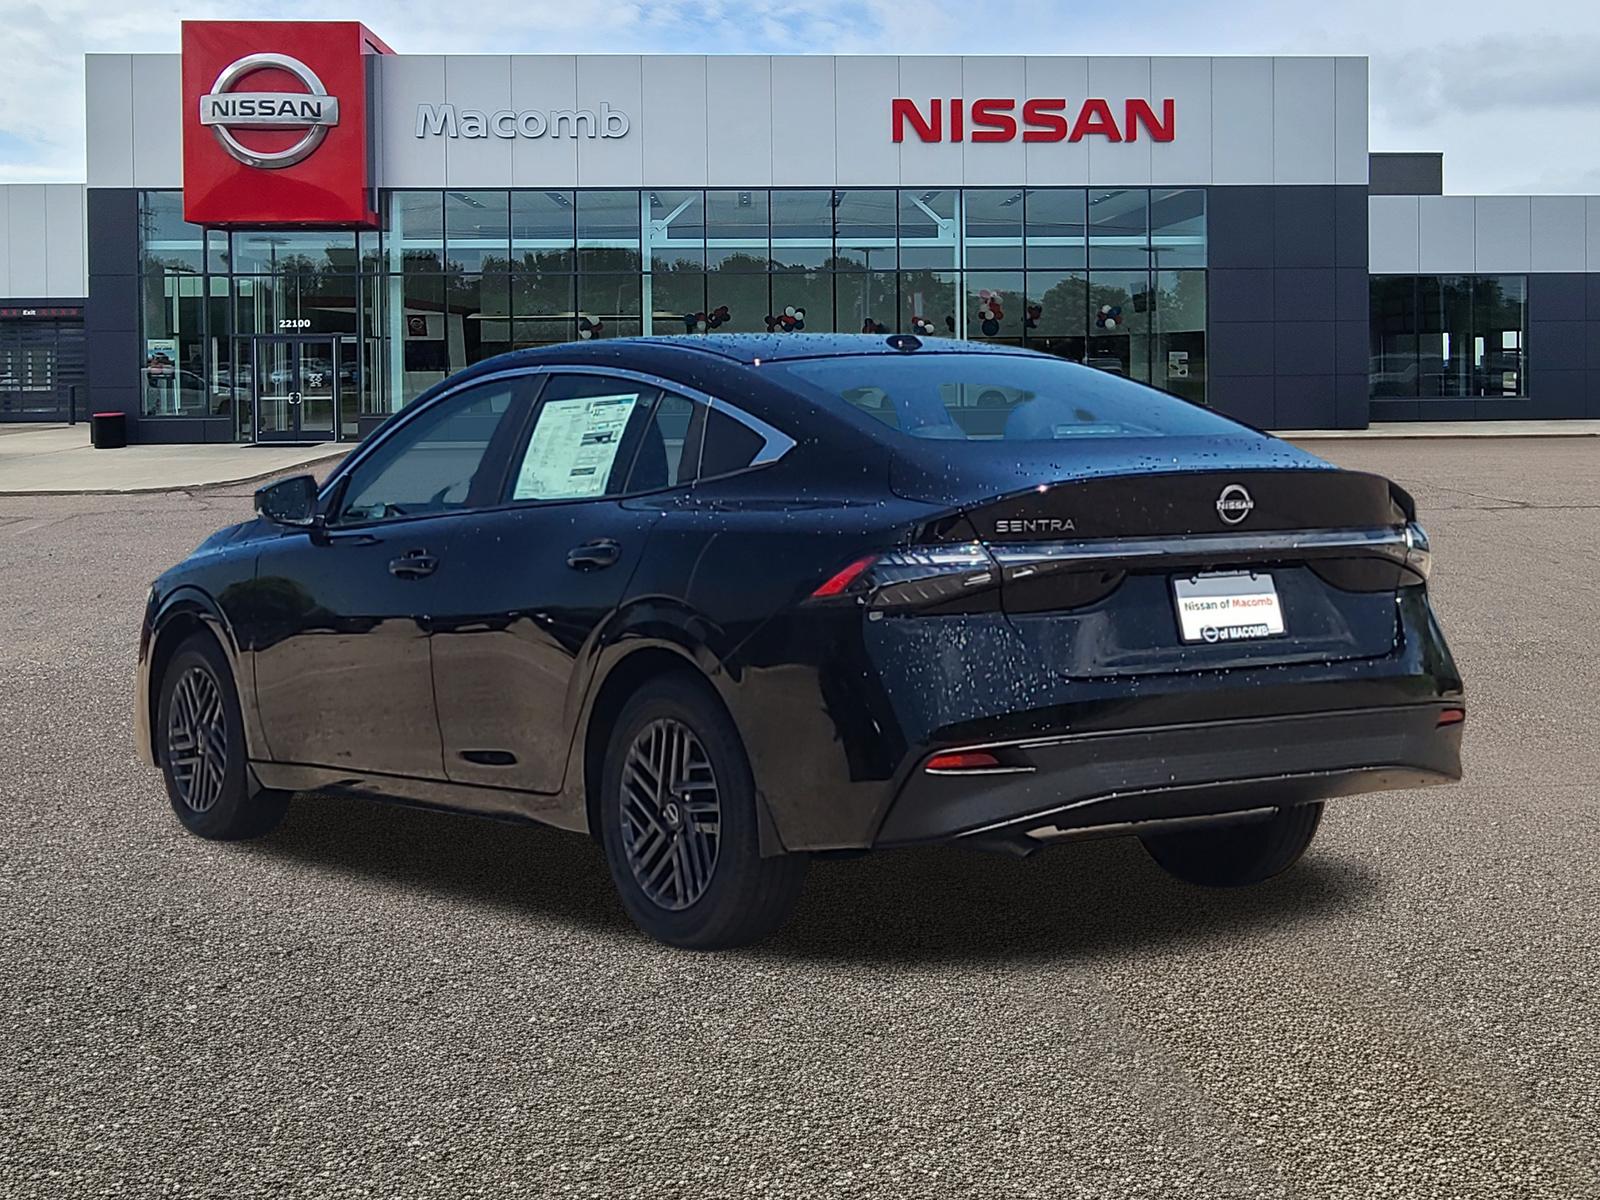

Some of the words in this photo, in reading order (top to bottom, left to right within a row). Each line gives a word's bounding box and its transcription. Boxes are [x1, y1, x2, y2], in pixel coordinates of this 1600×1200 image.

[211, 99, 322, 118] NISSAN
[415, 102, 630, 139] Macomb
[892, 98, 1175, 143] NISSAN
[279, 319, 311, 328] 22100
[1216, 500, 1254, 510] NISSAN
[995, 519, 1076, 533] SENTRA
[1184, 600, 1218, 612] Nissan
[1220, 599, 1230, 609] of
[1232, 597, 1273, 608] Macomb
[1220, 629, 1229, 639] of
[1229, 625, 1269, 639] MACOMB
